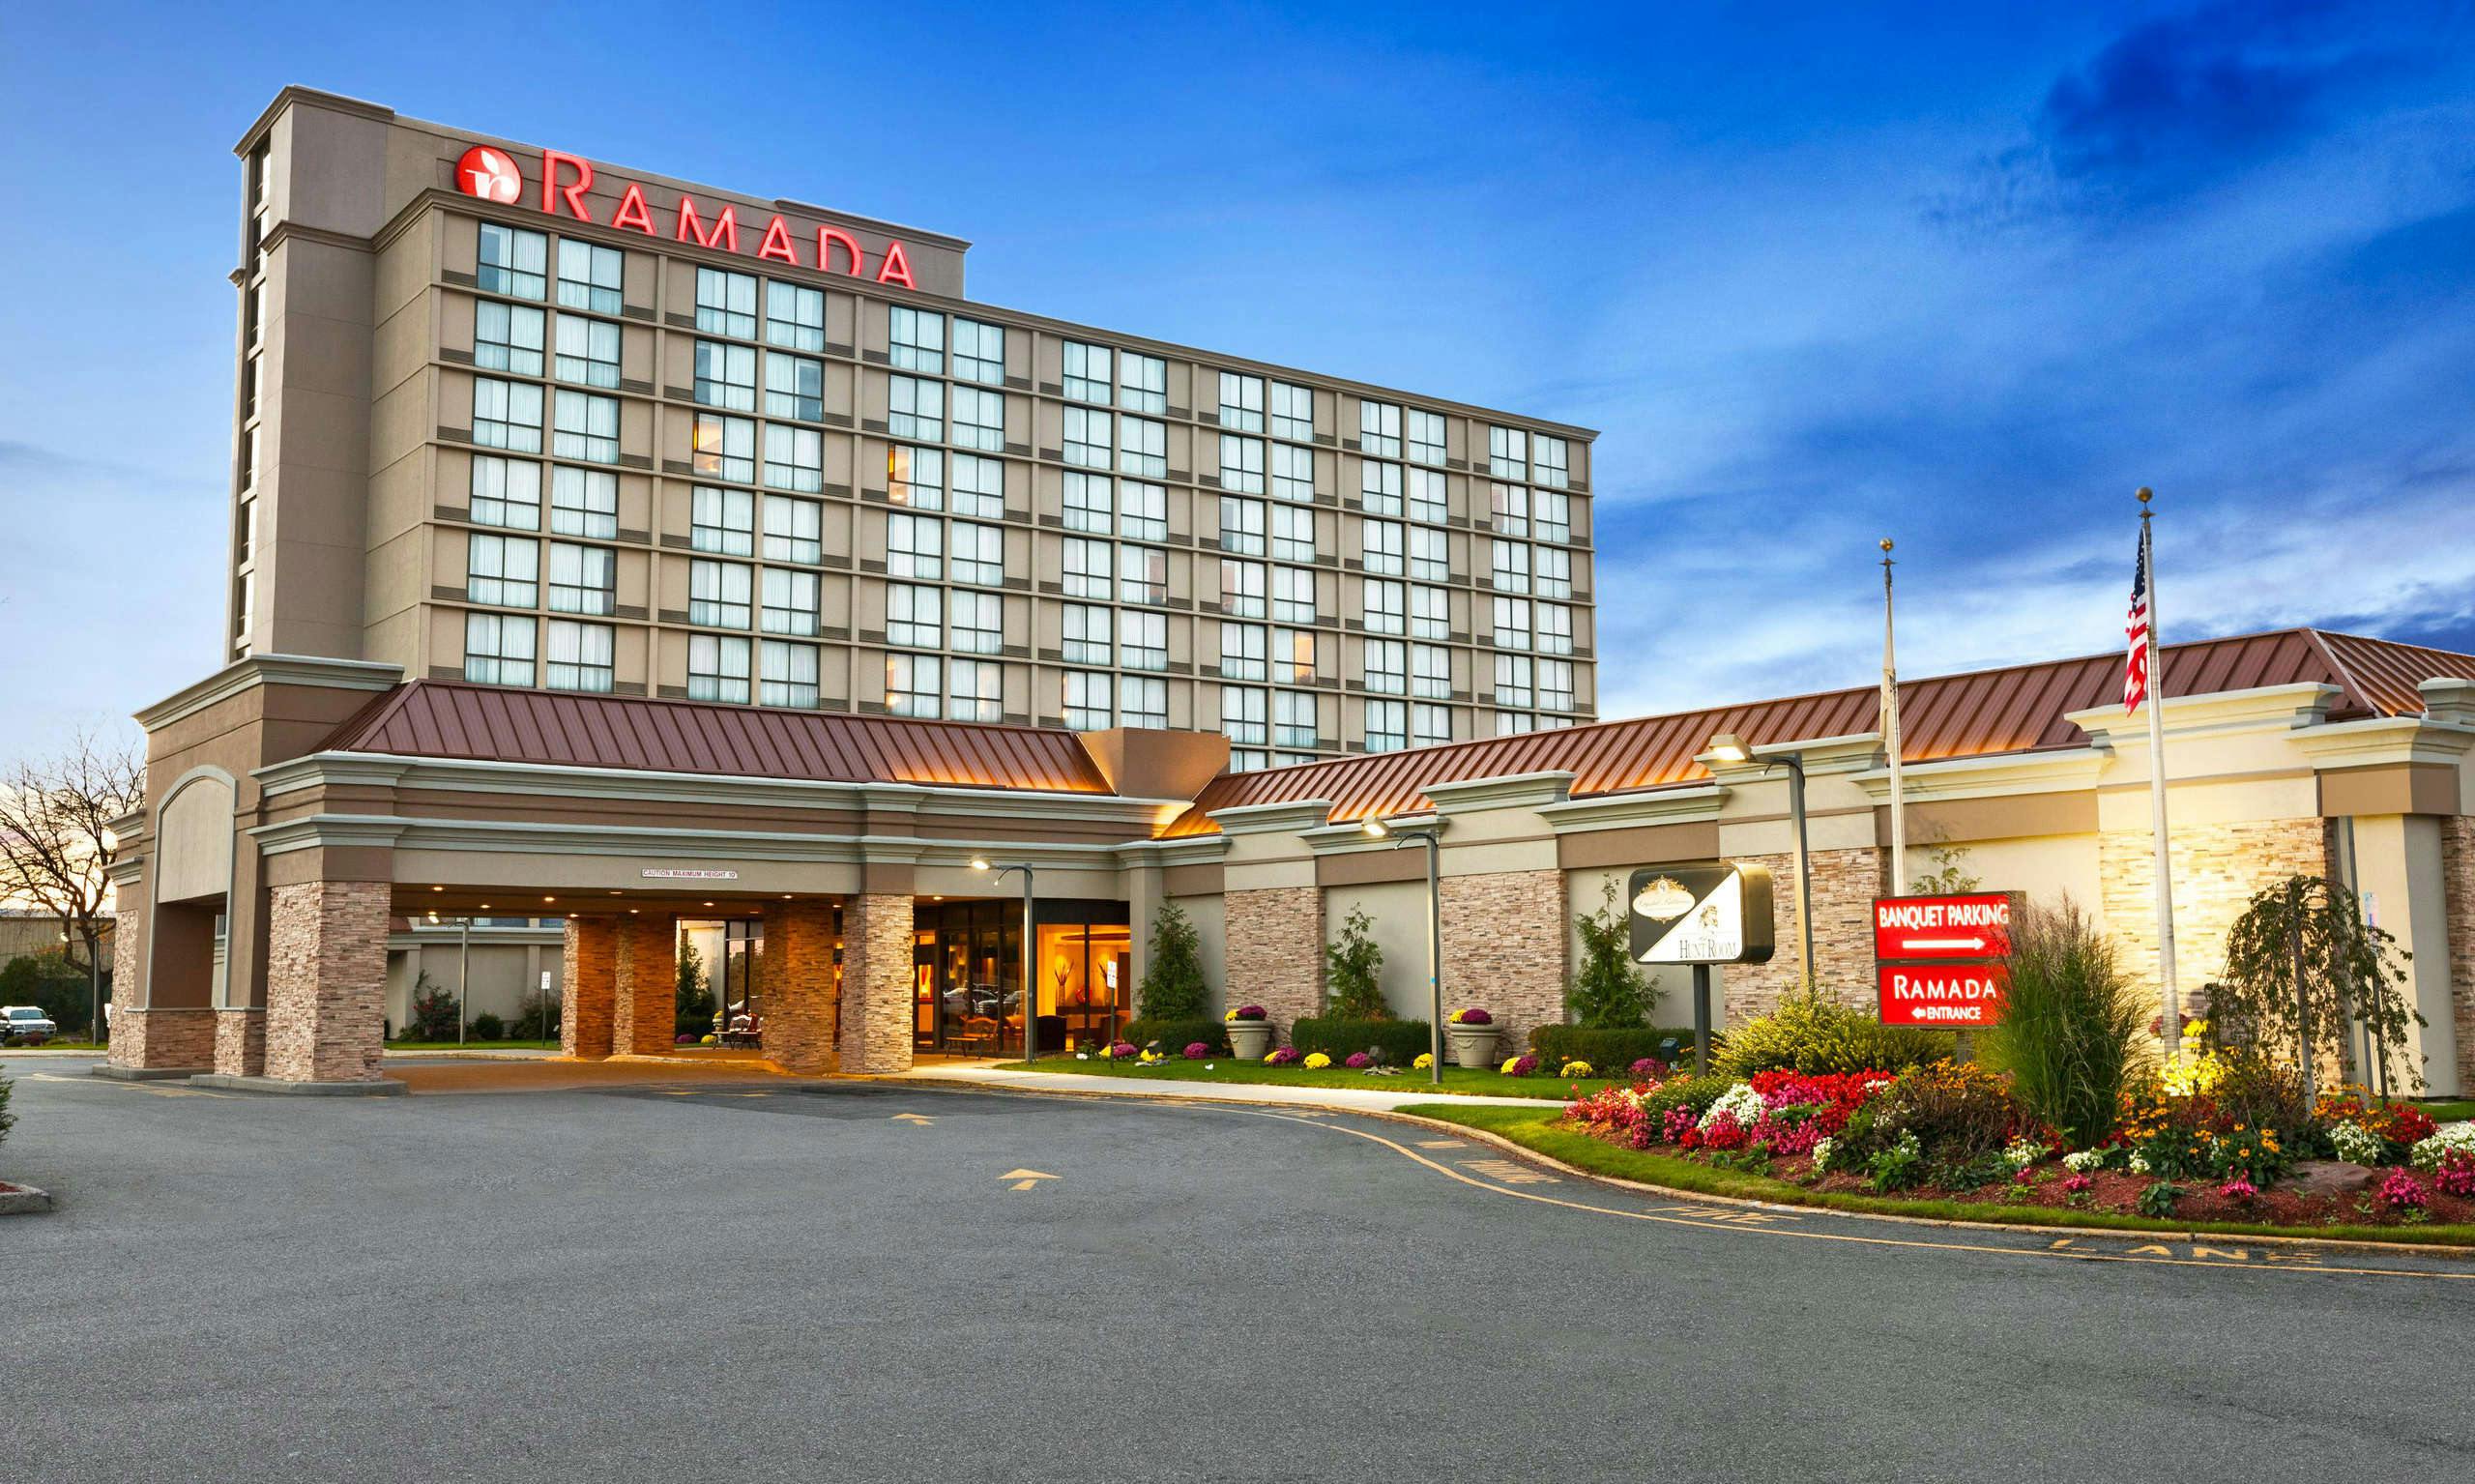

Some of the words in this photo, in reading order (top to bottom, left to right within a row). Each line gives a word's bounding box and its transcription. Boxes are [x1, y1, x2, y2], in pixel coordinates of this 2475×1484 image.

[542, 148, 917, 290] RAMADA
[1878, 905, 1944, 930] BANQUET
[1947, 904, 2009, 926] PARKING
[1679, 939, 1706, 958] HUNT
[1707, 938, 1736, 958] ROOM
[1893, 975, 1996, 1000] RAMADA
[1927, 1006, 1981, 1020] ENTRANCE
[2049, 1238, 2322, 1265] LANE
